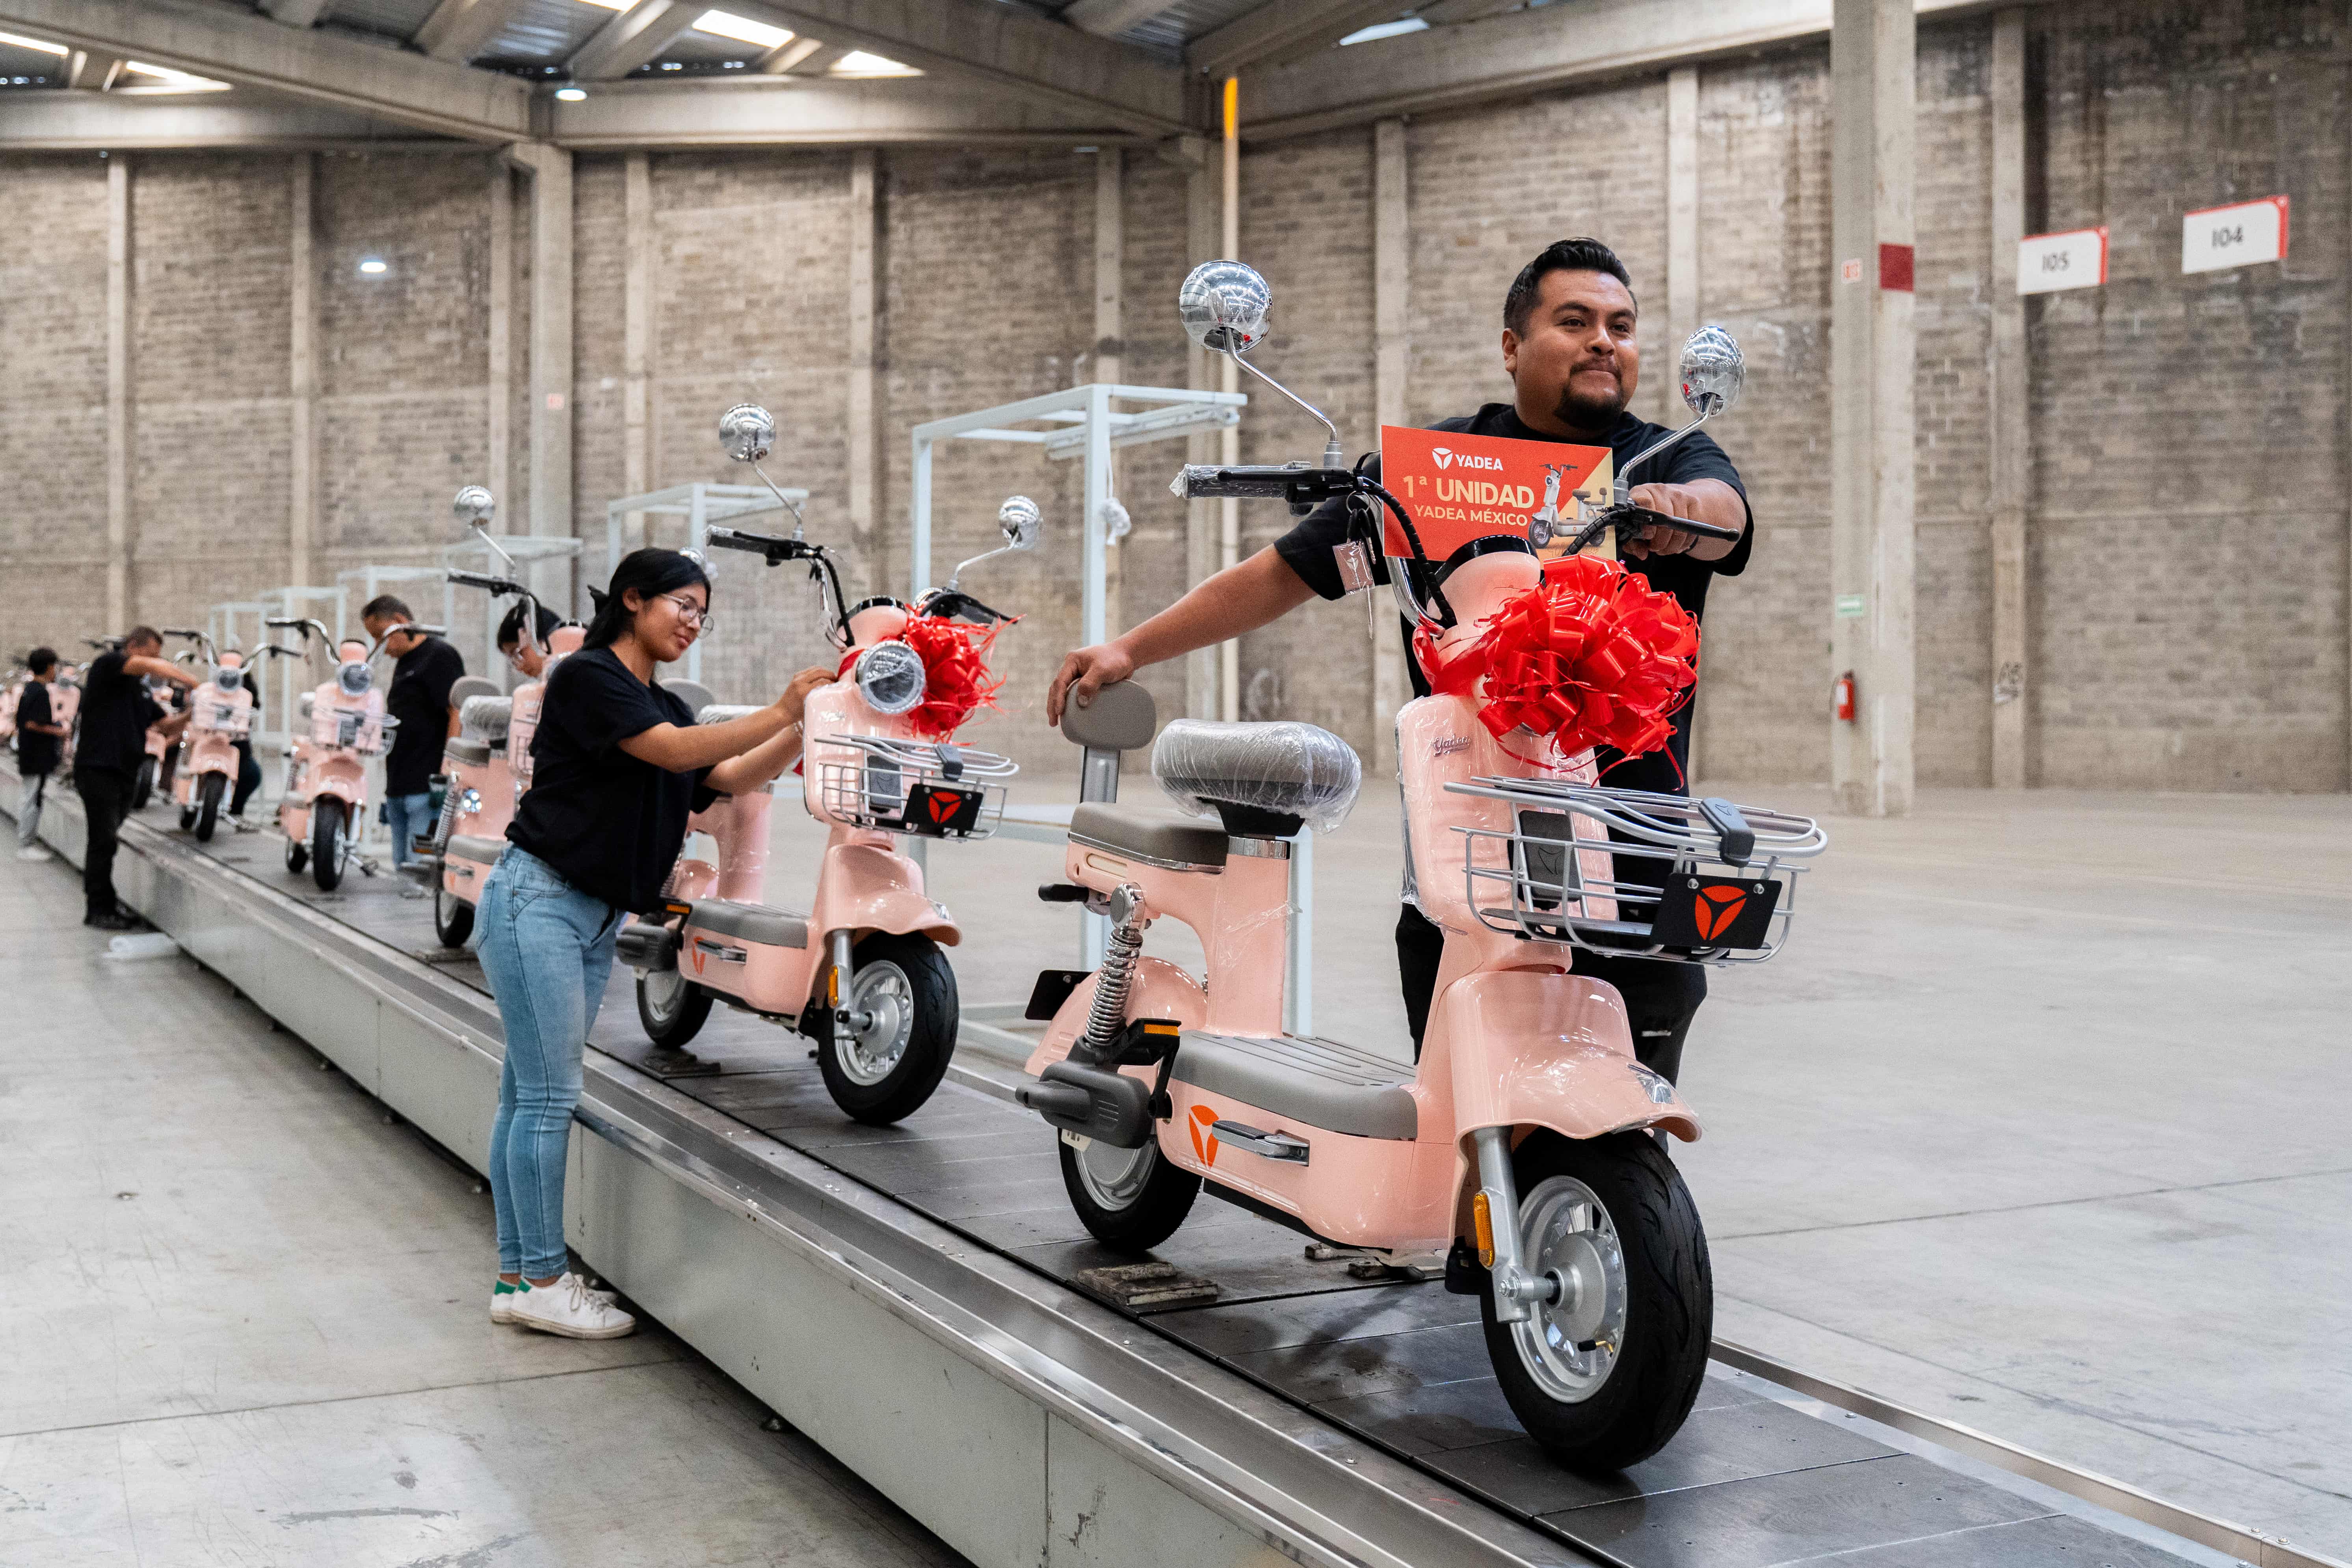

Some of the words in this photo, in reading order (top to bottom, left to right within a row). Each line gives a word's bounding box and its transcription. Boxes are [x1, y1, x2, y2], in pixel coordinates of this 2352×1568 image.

[2212, 223, 2244, 249] 104
[2042, 251, 2071, 273] 105
[1455, 454, 1503, 471] YADEA
[1436, 478, 1535, 509] UNIDAD
[1414, 504, 1466, 521] YADEA
[1470, 508, 1528, 527] MÉXICO
